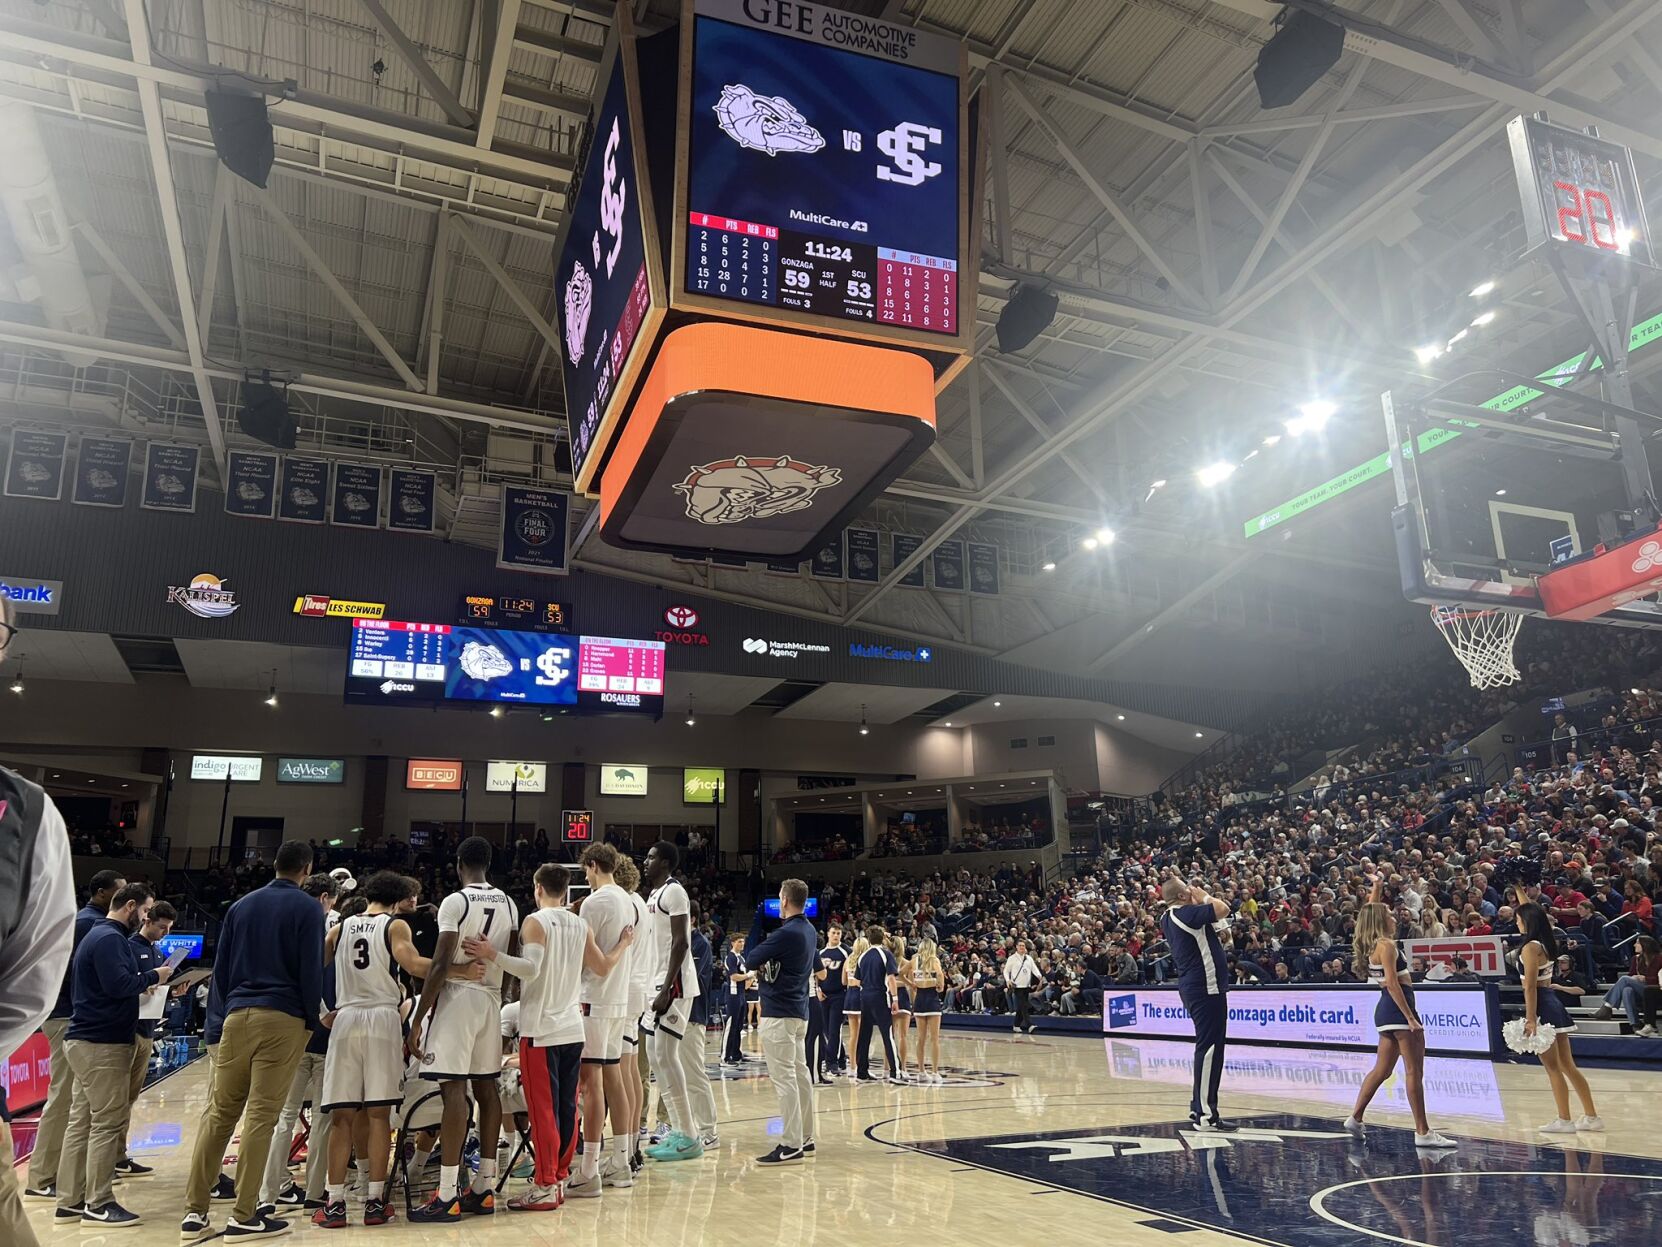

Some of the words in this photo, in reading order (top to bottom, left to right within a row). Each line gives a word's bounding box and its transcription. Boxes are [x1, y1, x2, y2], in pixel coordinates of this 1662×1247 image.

[743, 0, 814, 35] GEE
[822, 12, 916, 47] AUTOMOTIVE
[822, 27, 908, 60] COMPANIES
[790, 209, 850, 229] MultiCare
[1552, 180, 1619, 250] 20
[726, 220, 738, 230] PTS
[766, 228, 776, 237] FLS
[701, 230, 707, 240] 2
[722, 235, 728, 244] 6
[742, 238, 749, 247] 2
[763, 242, 769, 250] 0
[701, 243, 707, 252] 5
[722, 247, 728, 256] 5
[742, 250, 748, 259] 2
[763, 254, 768, 262] 3
[805, 241, 852, 262] 11:24
[701, 256, 707, 265] 8
[722, 259, 728, 268] 0
[742, 262, 748, 271] 4
[762, 266, 768, 274] 3
[781, 258, 814, 270] GONZAGA
[887, 264, 892, 272] 0
[903, 267, 912, 275] 11
[924, 270, 929, 279] 2
[698, 268, 709, 277] 15
[718, 270, 730, 280] 28
[742, 274, 748, 283] 7
[763, 278, 768, 287] 1
[785, 269, 810, 288] 59
[852, 270, 866, 279] SCU
[697, 280, 708, 289] 17
[720, 283, 726, 292] 0
[742, 287, 748, 296] 0
[762, 290, 768, 299] 2
[820, 280, 836, 288] HALF
[847, 280, 872, 299] 53
[888, 276, 891, 284] 1
[905, 279, 910, 287] 8
[924, 282, 929, 290] 3
[944, 285, 949, 294] 1
[804, 300, 811, 308] 3
[887, 288, 892, 296] 8
[905, 291, 910, 299] 6
[924, 294, 929, 302] 2
[944, 297, 949, 305] 3
[866, 310, 872, 318] 4
[884, 299, 894, 308] 15
[905, 302, 910, 310] 3
[924, 305, 929, 313] 6
[944, 308, 949, 316] 0
[883, 310, 894, 319] 22
[902, 314, 912, 322] 11
[924, 317, 929, 325] 8
[944, 320, 949, 328] 3
[1641, 321, 1662, 337] TEA
[514, 498, 558, 508] BASKETBALL
[524, 519, 546, 527] FINAL
[524, 527, 545, 536] FOUR
[166, 586, 236, 604] KALISPEL
[329, 604, 343, 612] LES
[345, 605, 382, 615] SCHWAB
[473, 606, 488, 616] 59
[505, 600, 533, 611] 11:24
[548, 613, 562, 623] 53
[655, 632, 709, 645] TOYOTA
[769, 641, 830, 652] MarshMcLennan
[770, 649, 798, 658] Agency
[849, 643, 912, 660] MultiCare
[601, 693, 640, 703] ROSAUERS
[194, 760, 226, 773] indigo
[282, 763, 330, 778] AgWest
[416, 770, 453, 779] BECU
[568, 823, 586, 838] 20
[350, 923, 376, 934] SMTH
[484, 908, 495, 937] 7
[354, 938, 370, 970] 3
[1142, 1003, 1161, 1018] The
[1229, 1008, 1275, 1026] onzaga
[1279, 1004, 1316, 1022] debit
[1320, 1006, 1359, 1025] card.
[1421, 1014, 1480, 1028] MERICA
[10, 1062, 30, 1085] TOYOTA
